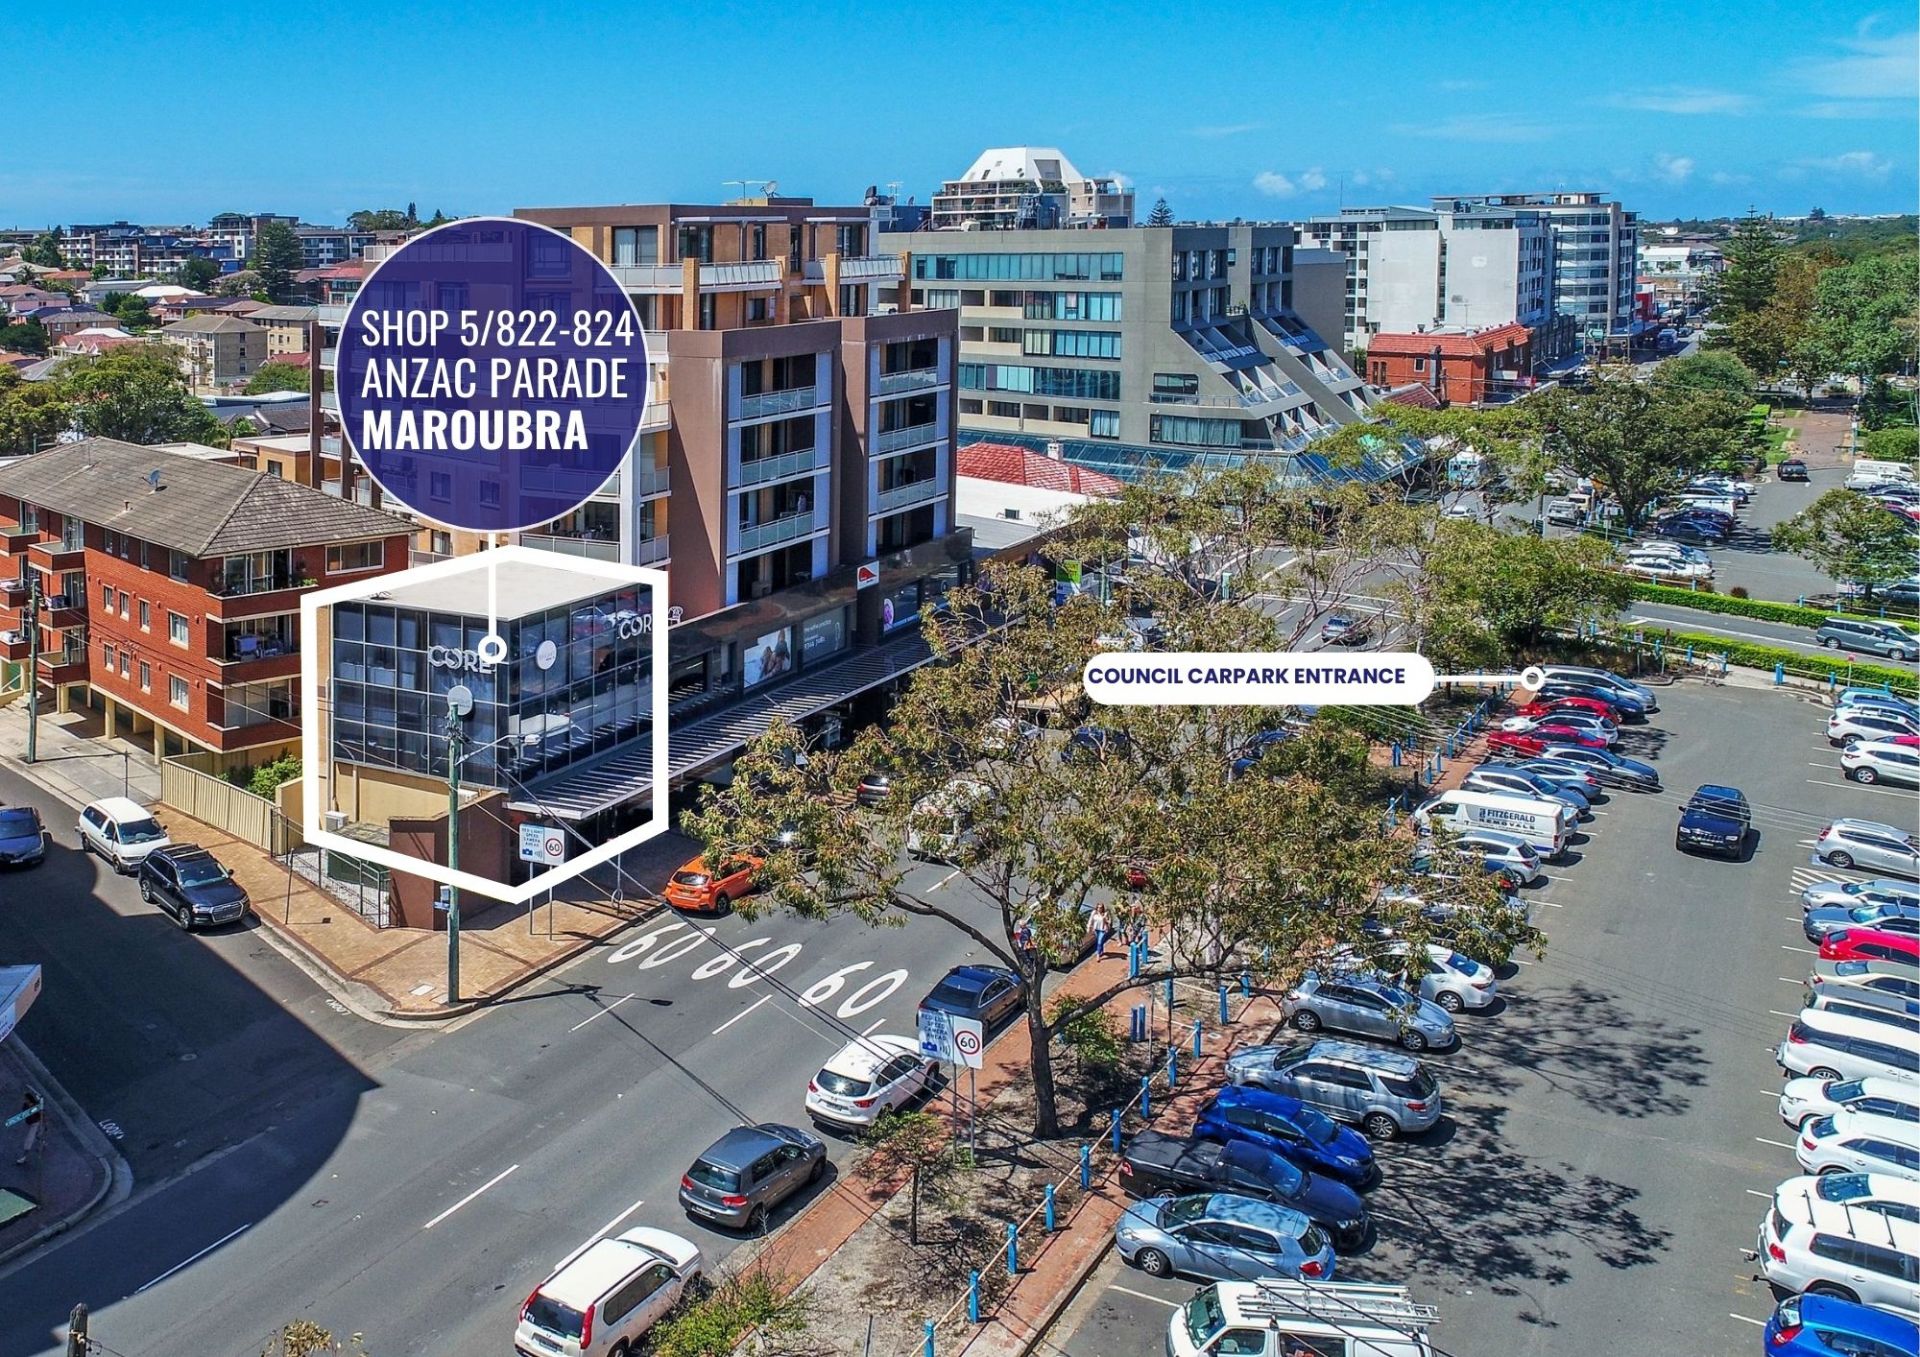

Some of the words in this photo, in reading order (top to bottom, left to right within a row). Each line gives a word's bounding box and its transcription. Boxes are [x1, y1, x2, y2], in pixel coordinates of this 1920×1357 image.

[620, 613, 653, 640] COR
[1487, 808, 1536, 823] FITZGERALD
[549, 843, 560, 852] 60
[607, 922, 716, 969] 60
[691, 937, 802, 988] 60
[798, 961, 908, 1018] 60
[960, 1037, 976, 1049] 60
